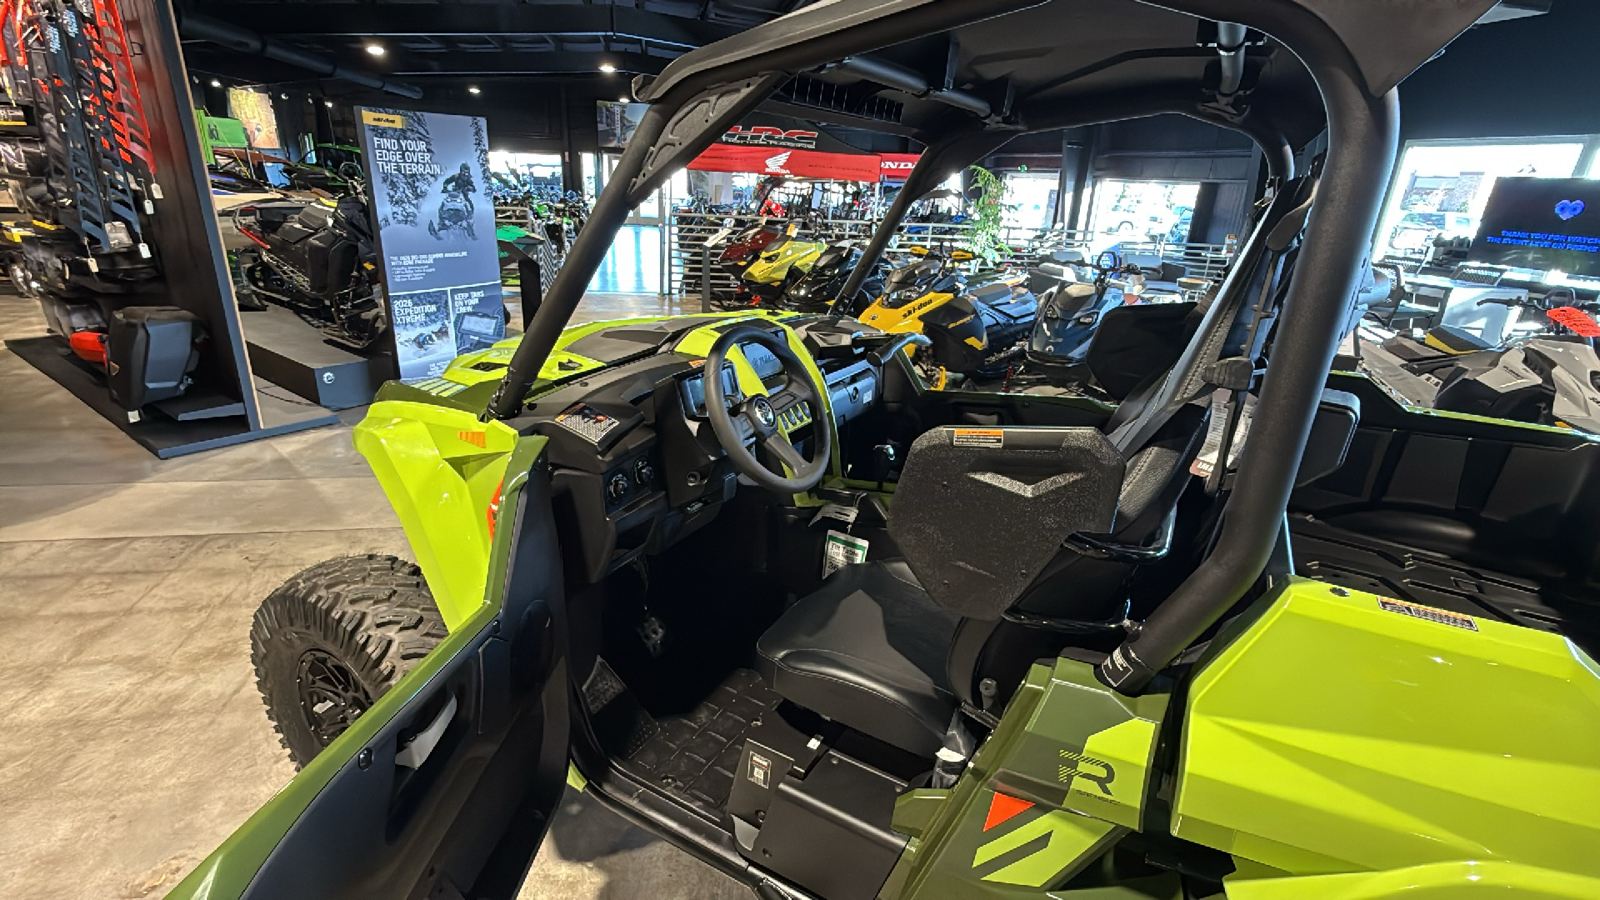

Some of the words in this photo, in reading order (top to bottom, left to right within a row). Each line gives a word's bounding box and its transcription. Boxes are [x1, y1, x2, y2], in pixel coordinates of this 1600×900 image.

[373, 136, 398, 151] FIND
[400, 139, 427, 152] YOUR
[375, 149, 403, 162] EDGE
[405, 151, 431, 163] OVER
[376, 161, 398, 174] THE
[399, 162, 444, 175] TERRAIN.
[1501, 230, 1530, 239] THANK
[1548, 234, 1567, 242] FOR
[1486, 236, 1502, 244] THE
[1530, 240, 1552, 248] LIVE
[1551, 242, 1566, 250] ON
[1566, 243, 1599, 253] PRIME
[454, 292, 469, 301] KEEP
[465, 298, 479, 306] YOUR
[394, 299, 413, 308] 2026
[902, 299, 933, 319] ski-doo
[395, 304, 437, 317] EXPEDITION
[396, 313, 426, 325] XTREME
